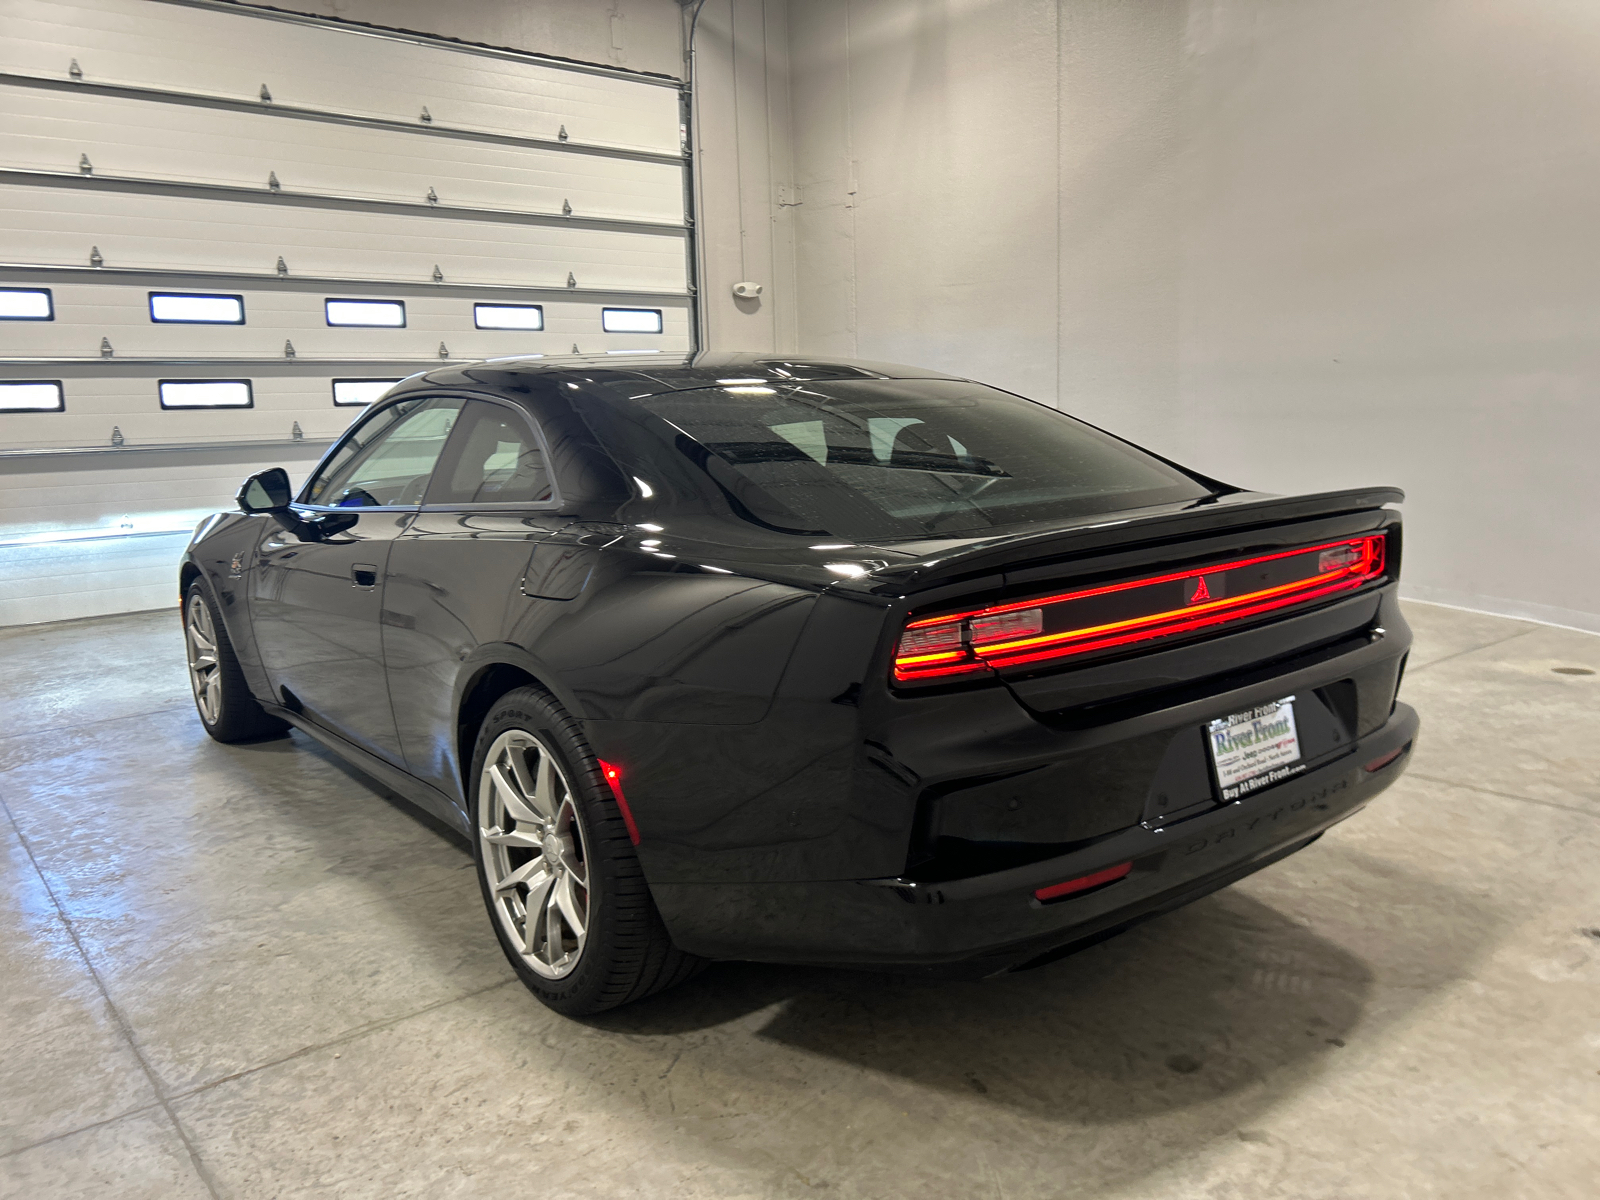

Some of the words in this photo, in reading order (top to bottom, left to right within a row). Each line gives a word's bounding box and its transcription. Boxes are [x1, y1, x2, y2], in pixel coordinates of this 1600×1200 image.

[493, 709, 533, 724] SPORT
[1228, 711, 1253, 727] River
[1254, 701, 1276, 718] Front
[1215, 729, 1252, 756] River
[1251, 716, 1290, 743] Front
[1222, 787, 1239, 800] Buy
[1240, 781, 1250, 794] At
[1248, 775, 1270, 790] River
[1269, 765, 1306, 781] Front.com
[1187, 781, 1347, 855] DAYTONA
